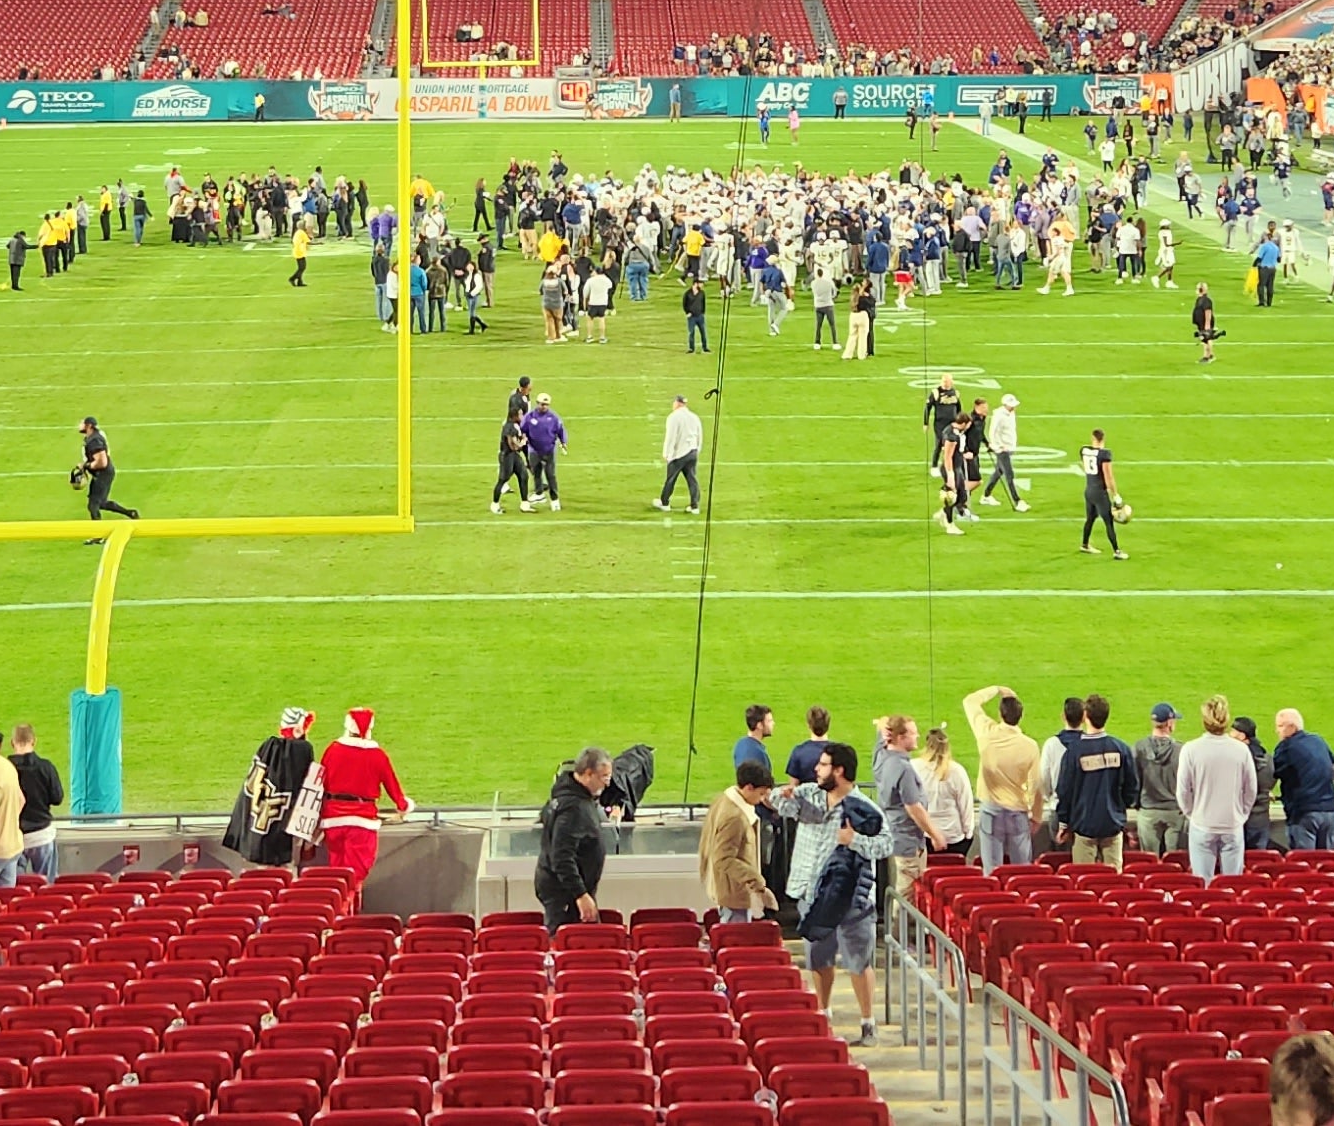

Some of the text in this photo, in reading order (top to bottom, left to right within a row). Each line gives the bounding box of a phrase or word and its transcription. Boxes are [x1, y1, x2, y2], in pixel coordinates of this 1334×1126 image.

[415, 84, 445, 94] UNION
[447, 84, 475, 94] HOME
[755, 82, 812, 102] ABC
[853, 84, 937, 100] SOURCE
[38, 91, 95, 102] TECO
[136, 99, 208, 109] ED MORSE
[395, 96, 552, 112] ASPARILA BOWL
